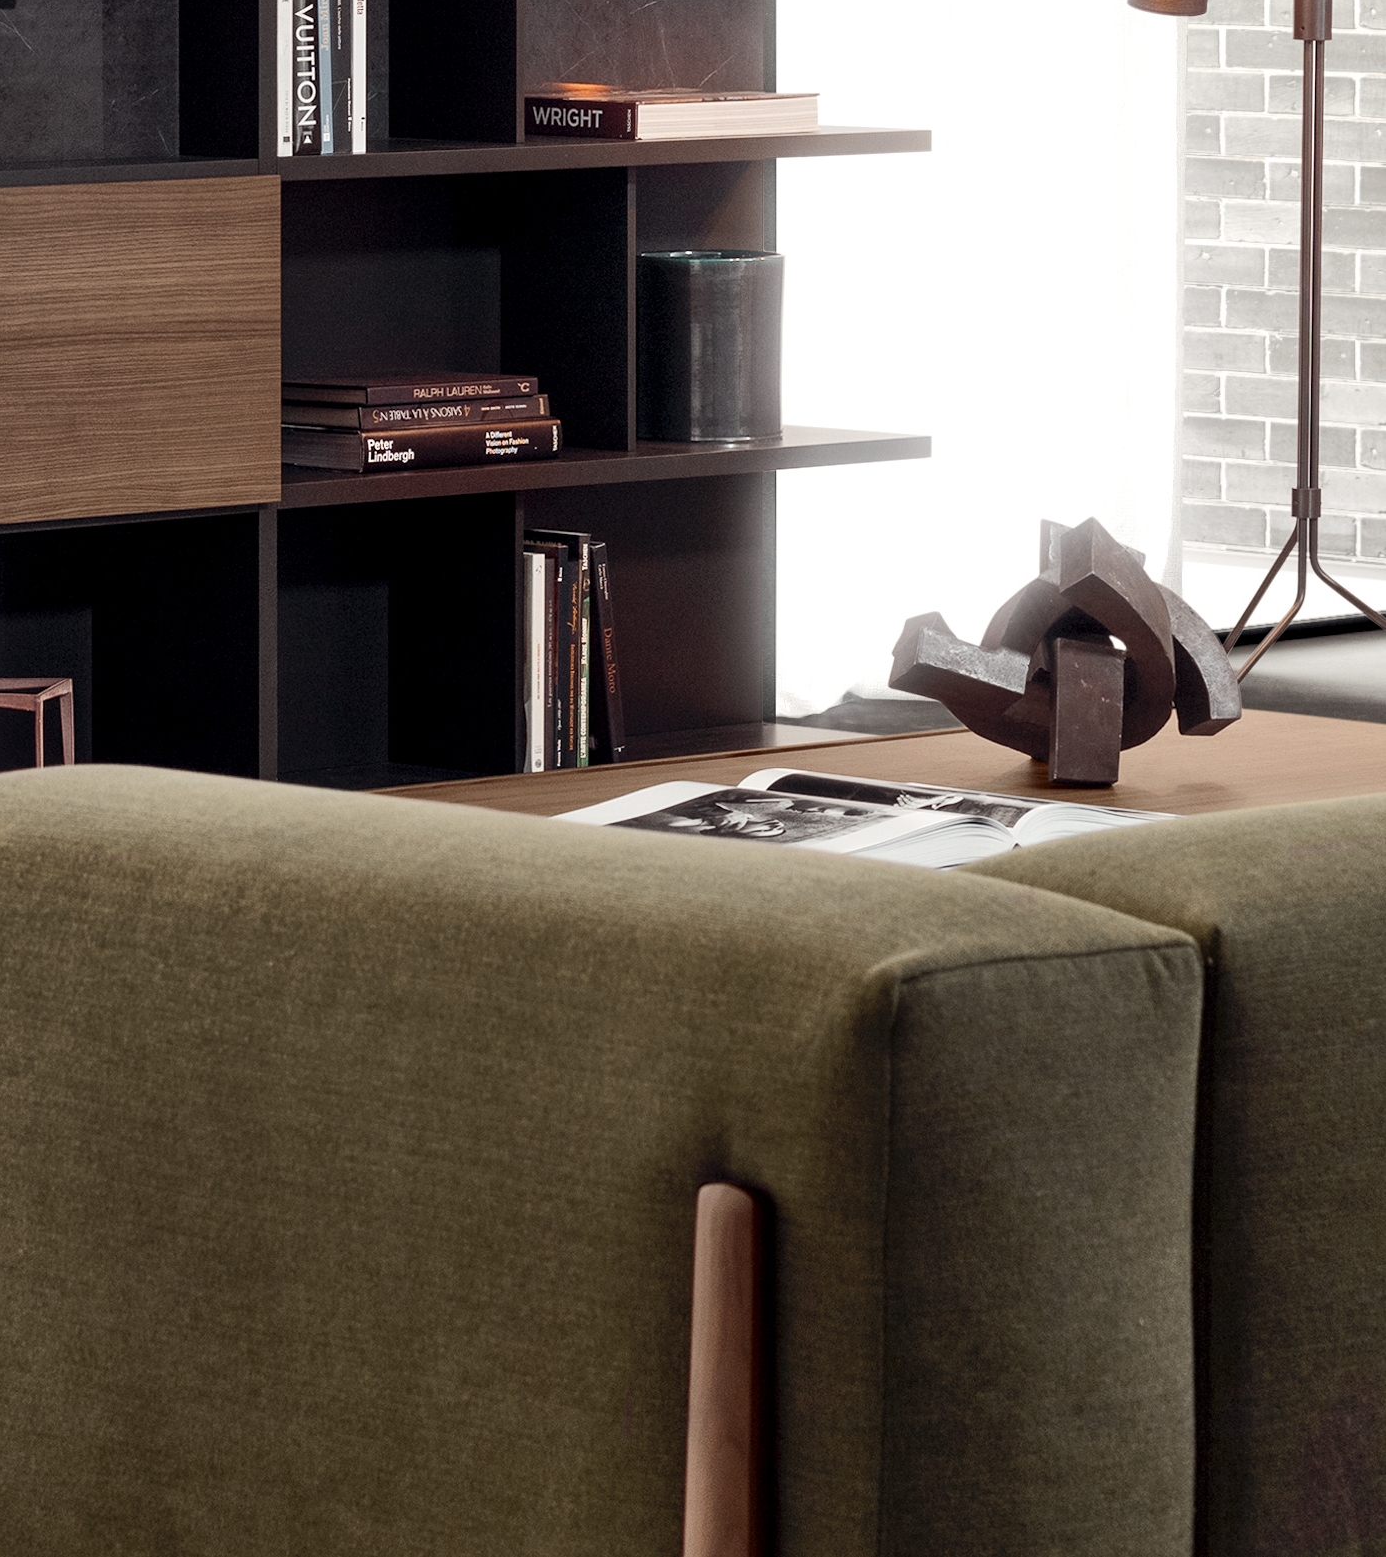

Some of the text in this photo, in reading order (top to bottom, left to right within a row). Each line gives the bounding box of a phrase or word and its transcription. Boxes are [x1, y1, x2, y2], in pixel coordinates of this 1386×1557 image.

[321, 21, 329, 51] Joan
[294, 3, 317, 127] VUITTON
[532, 106, 603, 129] WRIGHT
[413, 387, 444, 399] RALPH
[446, 384, 483, 397] LAUREN
[389, 408, 411, 421] TABLE
[412, 408, 422, 420] LA
[422, 408, 430, 421] À
[429, 405, 463, 419] SAISONS
[463, 404, 471, 417] 4
[485, 431, 491, 440] A
[367, 438, 394, 452] Peter
[501, 439, 509, 447] on
[367, 448, 415, 464] Lindbergh
[604, 627, 616, 694] Dante Moro
